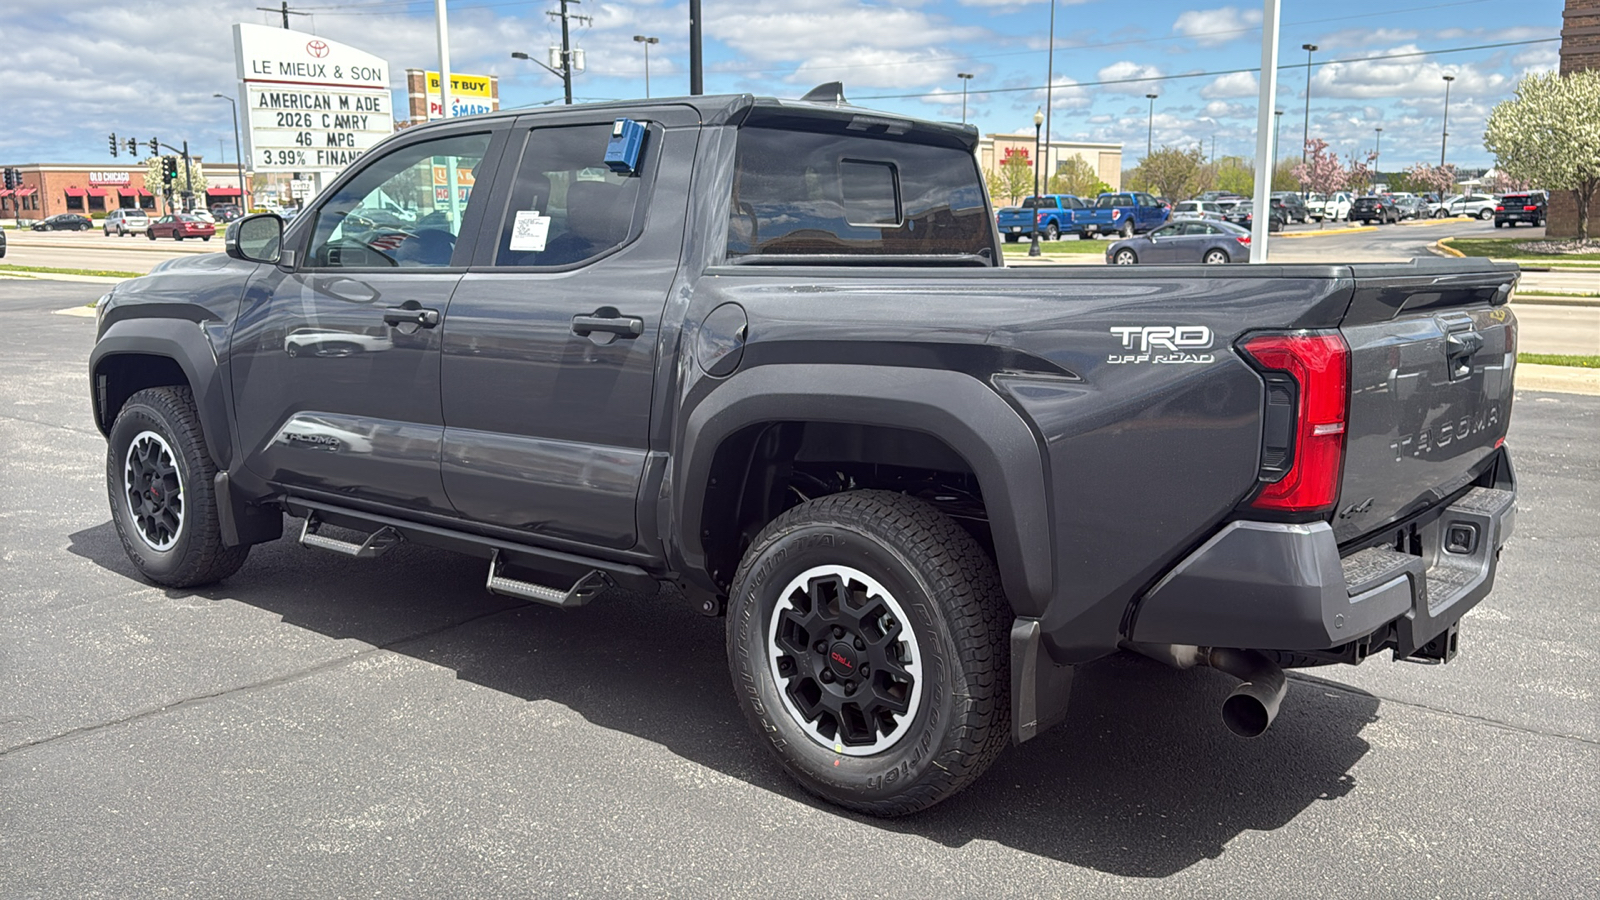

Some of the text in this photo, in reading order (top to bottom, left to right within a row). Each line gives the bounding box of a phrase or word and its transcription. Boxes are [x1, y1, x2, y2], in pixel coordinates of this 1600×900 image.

[252, 59, 382, 82] LE MIEUX & SON
[462, 81, 486, 91] BUY
[259, 92, 331, 110] AMERICAN
[277, 112, 312, 128] 2026
[295, 131, 355, 148] 46 MPG
[263, 150, 306, 165] 3.99%
[89, 172, 130, 182] OLD CHICAGO
[1110, 326, 1214, 355] TRD
[1106, 354, 1215, 364] OFF ROAD
[282, 431, 340, 446] TACOMA
[1390, 407, 1499, 463] TACOMA
[831, 652, 853, 668] TRD
